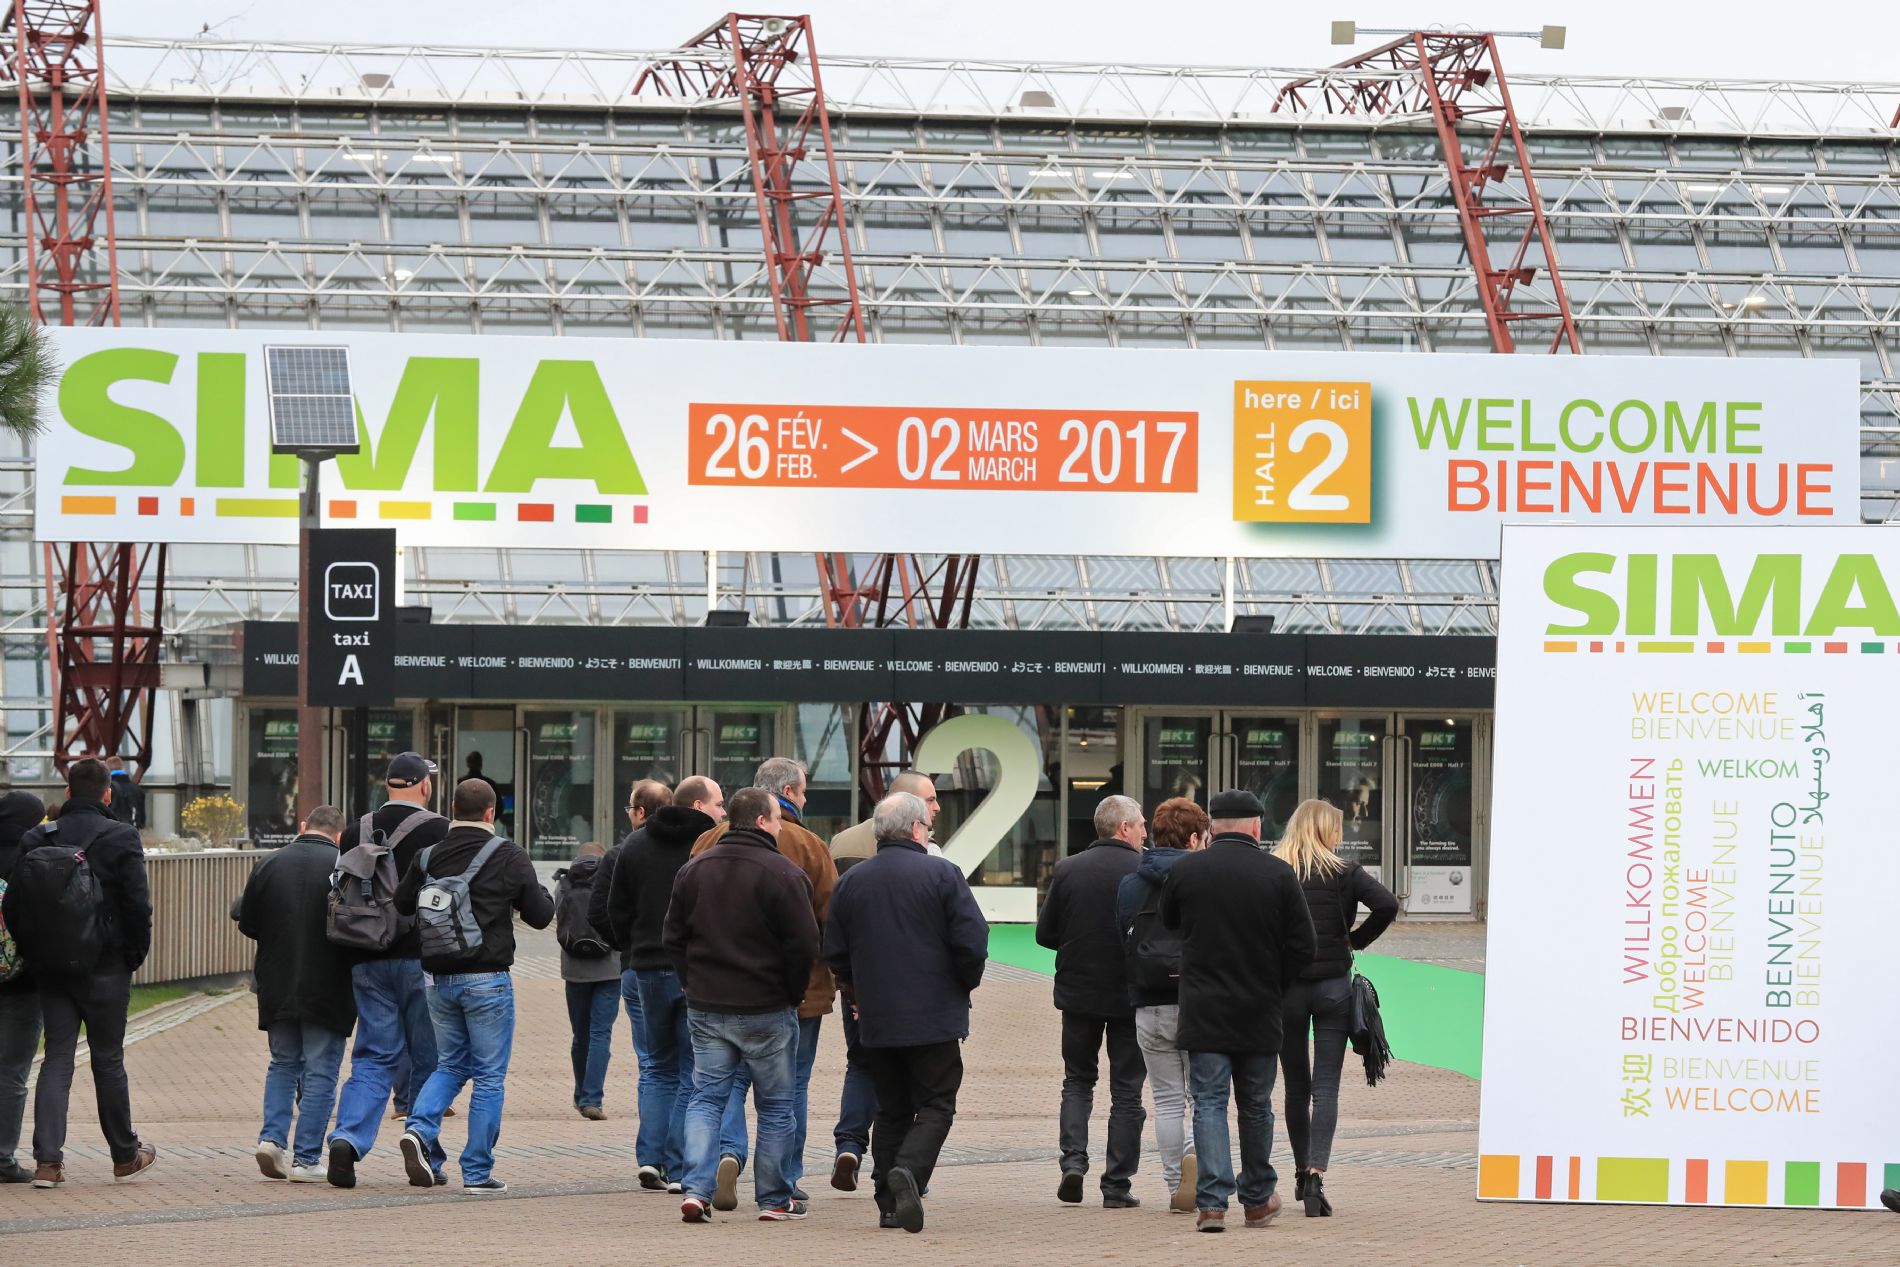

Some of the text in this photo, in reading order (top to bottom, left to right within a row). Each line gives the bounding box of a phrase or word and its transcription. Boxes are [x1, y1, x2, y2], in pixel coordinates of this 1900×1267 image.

[1244, 388, 1302, 410] here
[1329, 389, 1360, 410] ici
[57, 347, 649, 494] SIMA
[1407, 396, 1763, 454] WELCOME
[704, 410, 1187, 484] 26 FÉV. 02 MARS 2017
[777, 453, 1037, 482] FEB. MARCH
[1255, 422, 1276, 506] HALL
[1287, 418, 1350, 511] 2
[1447, 459, 1834, 517] BIENVENUE
[331, 583, 373, 599] TAXI
[1543, 552, 1900, 637] SIMA
[332, 631, 371, 646] taxi
[263, 653, 575, 669] WILLKO BIENVENUE WELCOME BIENVENIDO
[338, 654, 364, 686] A
[584, 658, 618, 669] ようこそ
[628, 658, 762, 670] BENVENUTI WILLKOMMEN
[823, 659, 999, 673] BIENVENUE WELCOME BIENVENIDO
[1011, 661, 1044, 674] ようこそ
[1054, 662, 1184, 674] BENVENUTI WILLKOMMEN
[1243, 664, 1415, 677] BIENVENUE WELCOME BIENVENIDO
[1425, 666, 1457, 678] ようこそ
[1467, 667, 1497, 678] BENVE
[1632, 691, 1777, 716] WELCOME
[368, 722, 395, 736] KT
[1631, 716, 1797, 740] BIENVENUE
[1697, 758, 1800, 779] WELKOM
[911, 713, 1041, 923] 2
[1622, 758, 1657, 984] WILLKOMMEN
[1652, 757, 1684, 1014] Добро пожаловать
[1708, 799, 1738, 981] BIENVENUE
[1765, 802, 1797, 1008] BENVENUTO
[1795, 835, 1825, 1006] BIENVENUE
[1682, 868, 1709, 1011] WELCOME
[1620, 1016, 1821, 1044] BIENVENIDO
[1663, 1057, 1821, 1082] BIENVENUE
[1620, 1053, 1653, 1118] 欢迎
[1664, 1086, 1822, 1114] WELCOME
